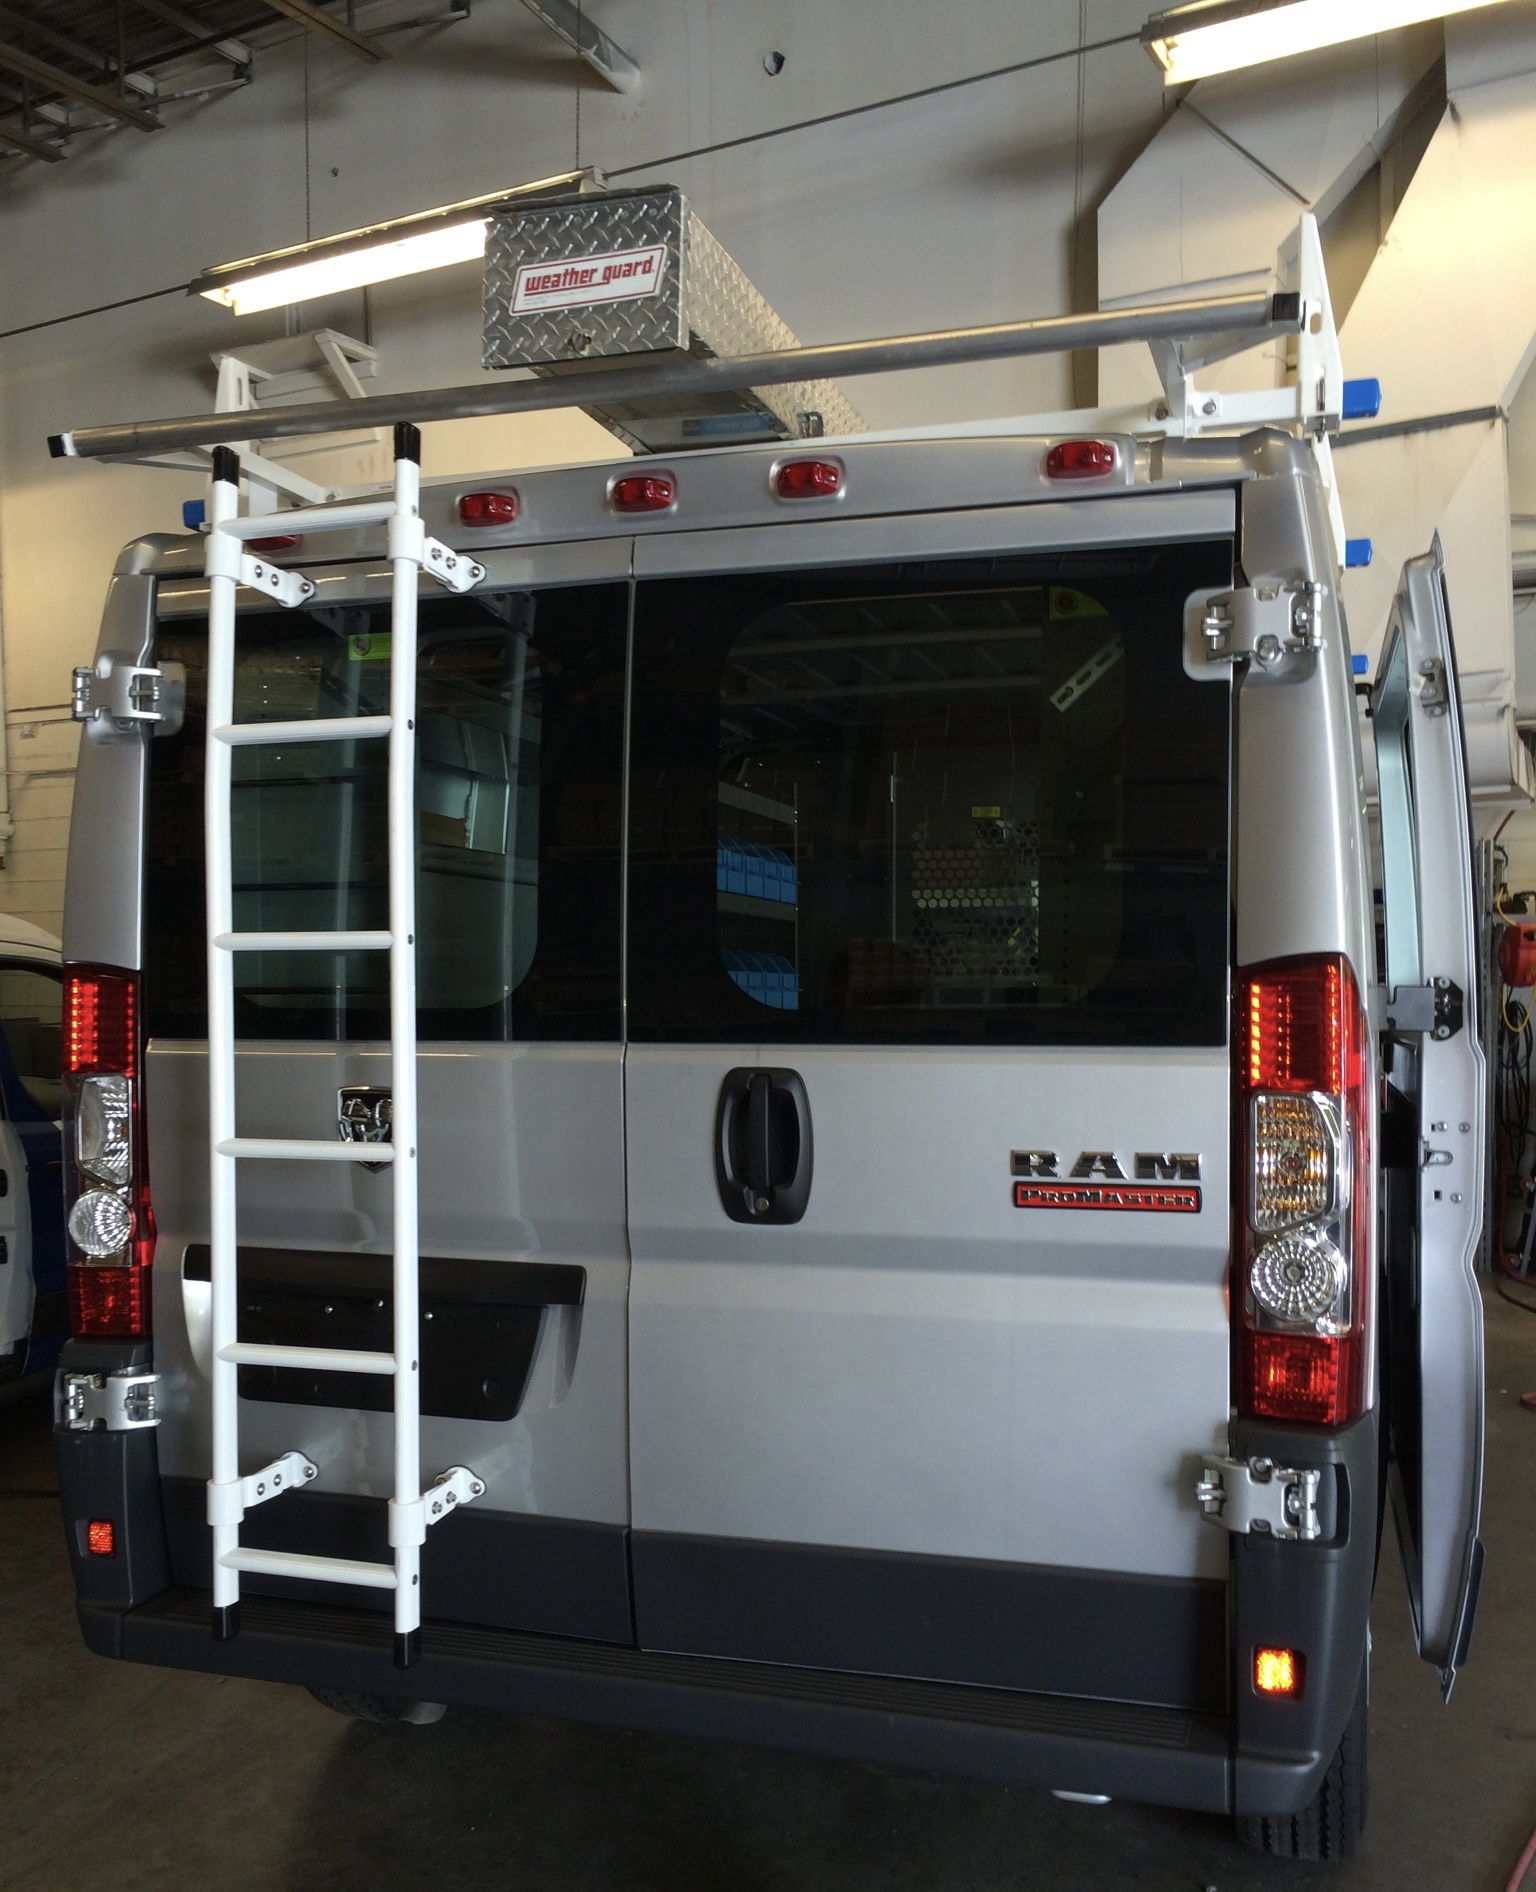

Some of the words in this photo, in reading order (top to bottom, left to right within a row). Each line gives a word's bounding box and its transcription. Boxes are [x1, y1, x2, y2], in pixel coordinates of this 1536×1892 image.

[525, 268, 598, 292] weather
[602, 256, 653, 285] guard
[1011, 1150, 1202, 1180] RAM
[1022, 1189, 1195, 1207] PROMASTER
